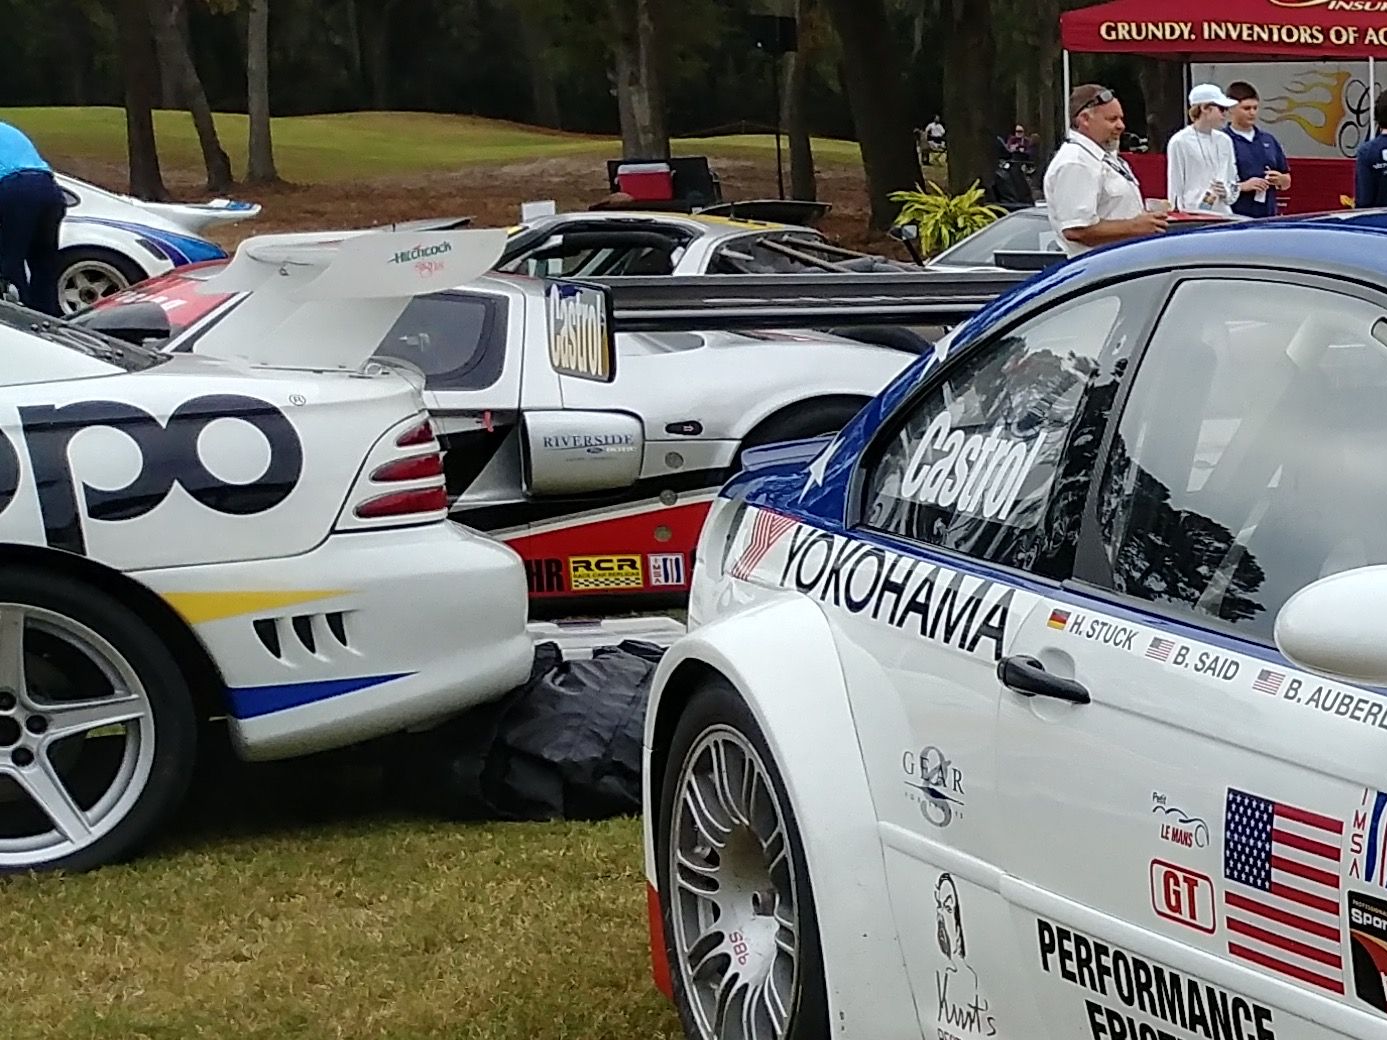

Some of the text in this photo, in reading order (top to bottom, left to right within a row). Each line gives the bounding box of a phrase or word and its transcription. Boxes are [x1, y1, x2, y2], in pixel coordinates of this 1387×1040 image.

[1100, 21, 1196, 41] GRUNDY.
[1203, 22, 1324, 44] INVENTORS
[1329, 26, 1359, 45] OF
[549, 283, 604, 376] Castrol
[543, 435, 634, 448] RIVERSIDE
[0, 393, 304, 557] po
[902, 411, 1047, 520] Castrol
[572, 559, 638, 572] RCR
[780, 524, 1016, 661] YOKOHAMA
[1069, 614, 1141, 651] H. STUCK
[1173, 647, 1240, 681] B. SAID
[1284, 679, 1302, 704] B.
[1160, 824, 1193, 848] LE MANS
[1163, 871, 1198, 921] GT
